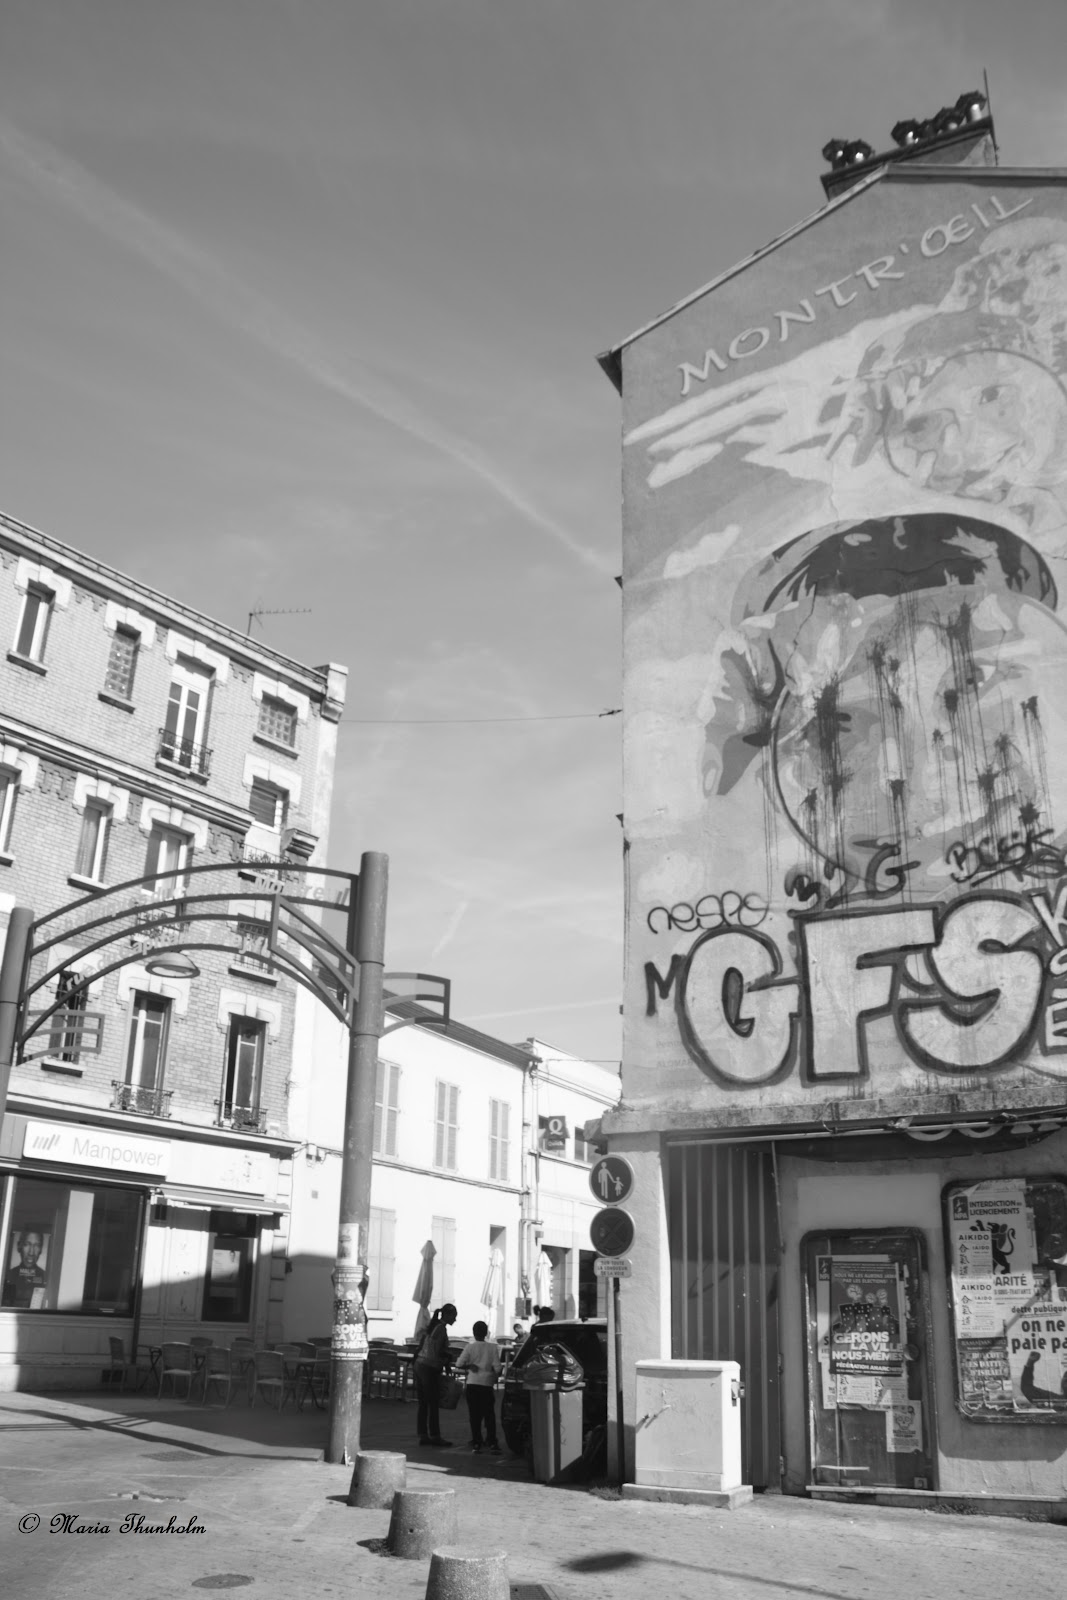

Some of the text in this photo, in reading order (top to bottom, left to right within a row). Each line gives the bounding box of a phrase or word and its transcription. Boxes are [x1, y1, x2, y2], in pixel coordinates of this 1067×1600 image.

[548, 1118, 563, 1135] Q
[73, 1137, 163, 1166] Manpower
[969, 1200, 1016, 1208] INTERDICTION
[969, 1208, 1020, 1216] LICENCIEMENTS
[1033, 1304, 1067, 1315] publique
[1021, 1319, 1066, 1332] on ne
[851, 1342, 904, 1353] LA VILLE
[1011, 1333, 1047, 1354] paie
